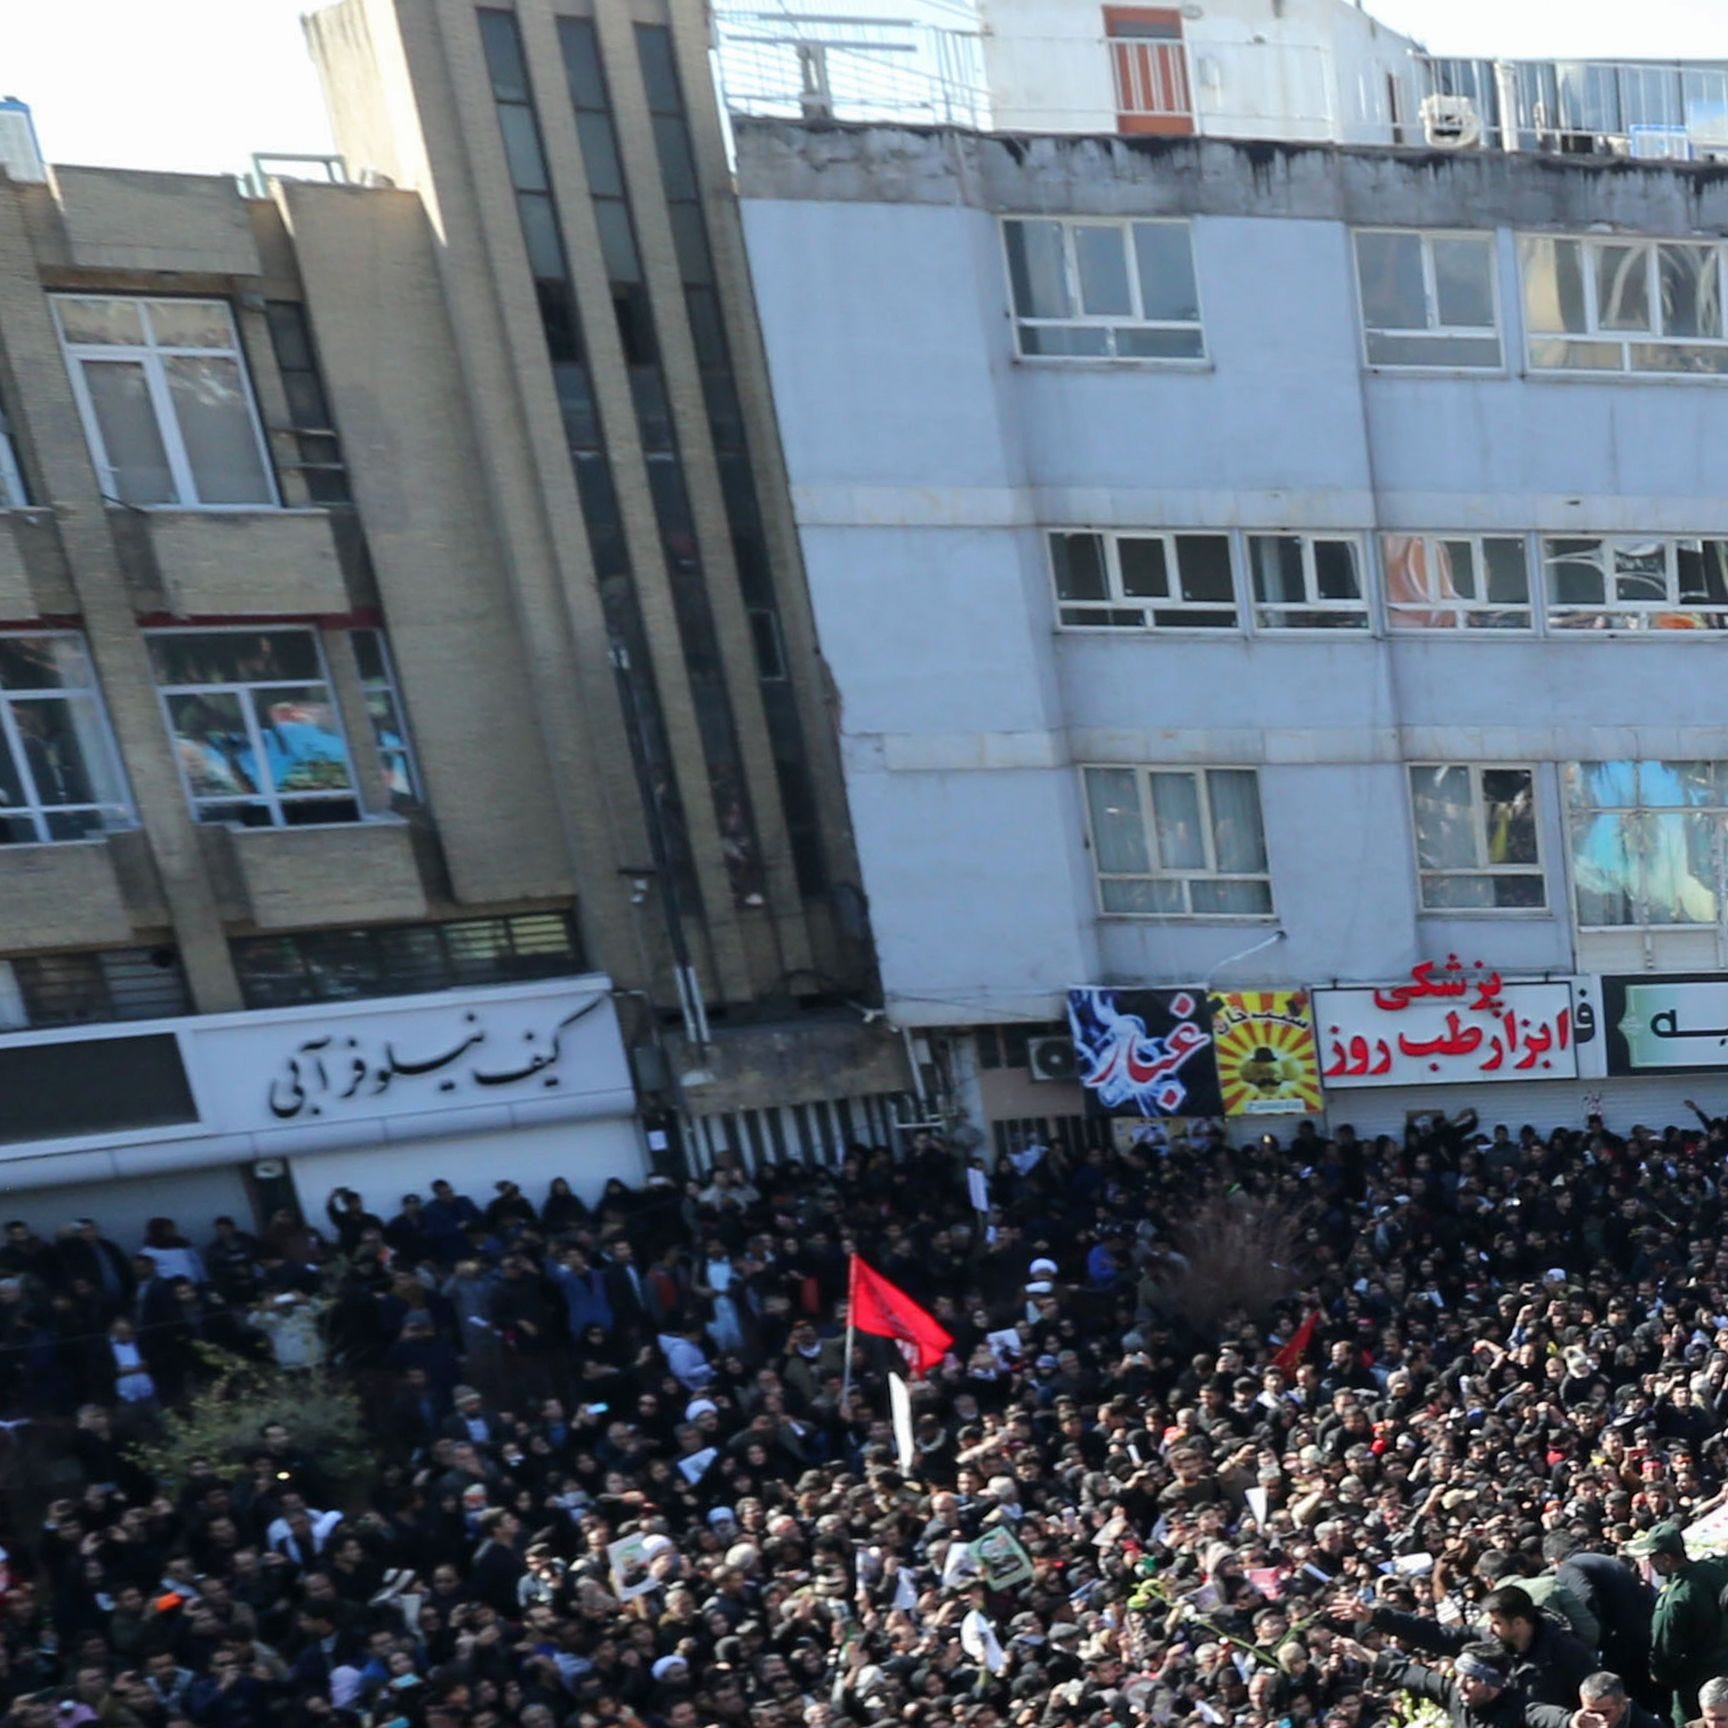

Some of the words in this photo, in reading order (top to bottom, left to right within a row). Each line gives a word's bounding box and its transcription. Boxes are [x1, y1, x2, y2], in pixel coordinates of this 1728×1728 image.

[1373, 953, 1504, 1019] پزشکی
[473, 997, 602, 1088] کیف
[1322, 1025, 1393, 1077] روز
[1397, 1009, 1484, 1073] طب
[1478, 1008, 1570, 1072] ابزار
[269, 1035, 332, 1119] آبی
